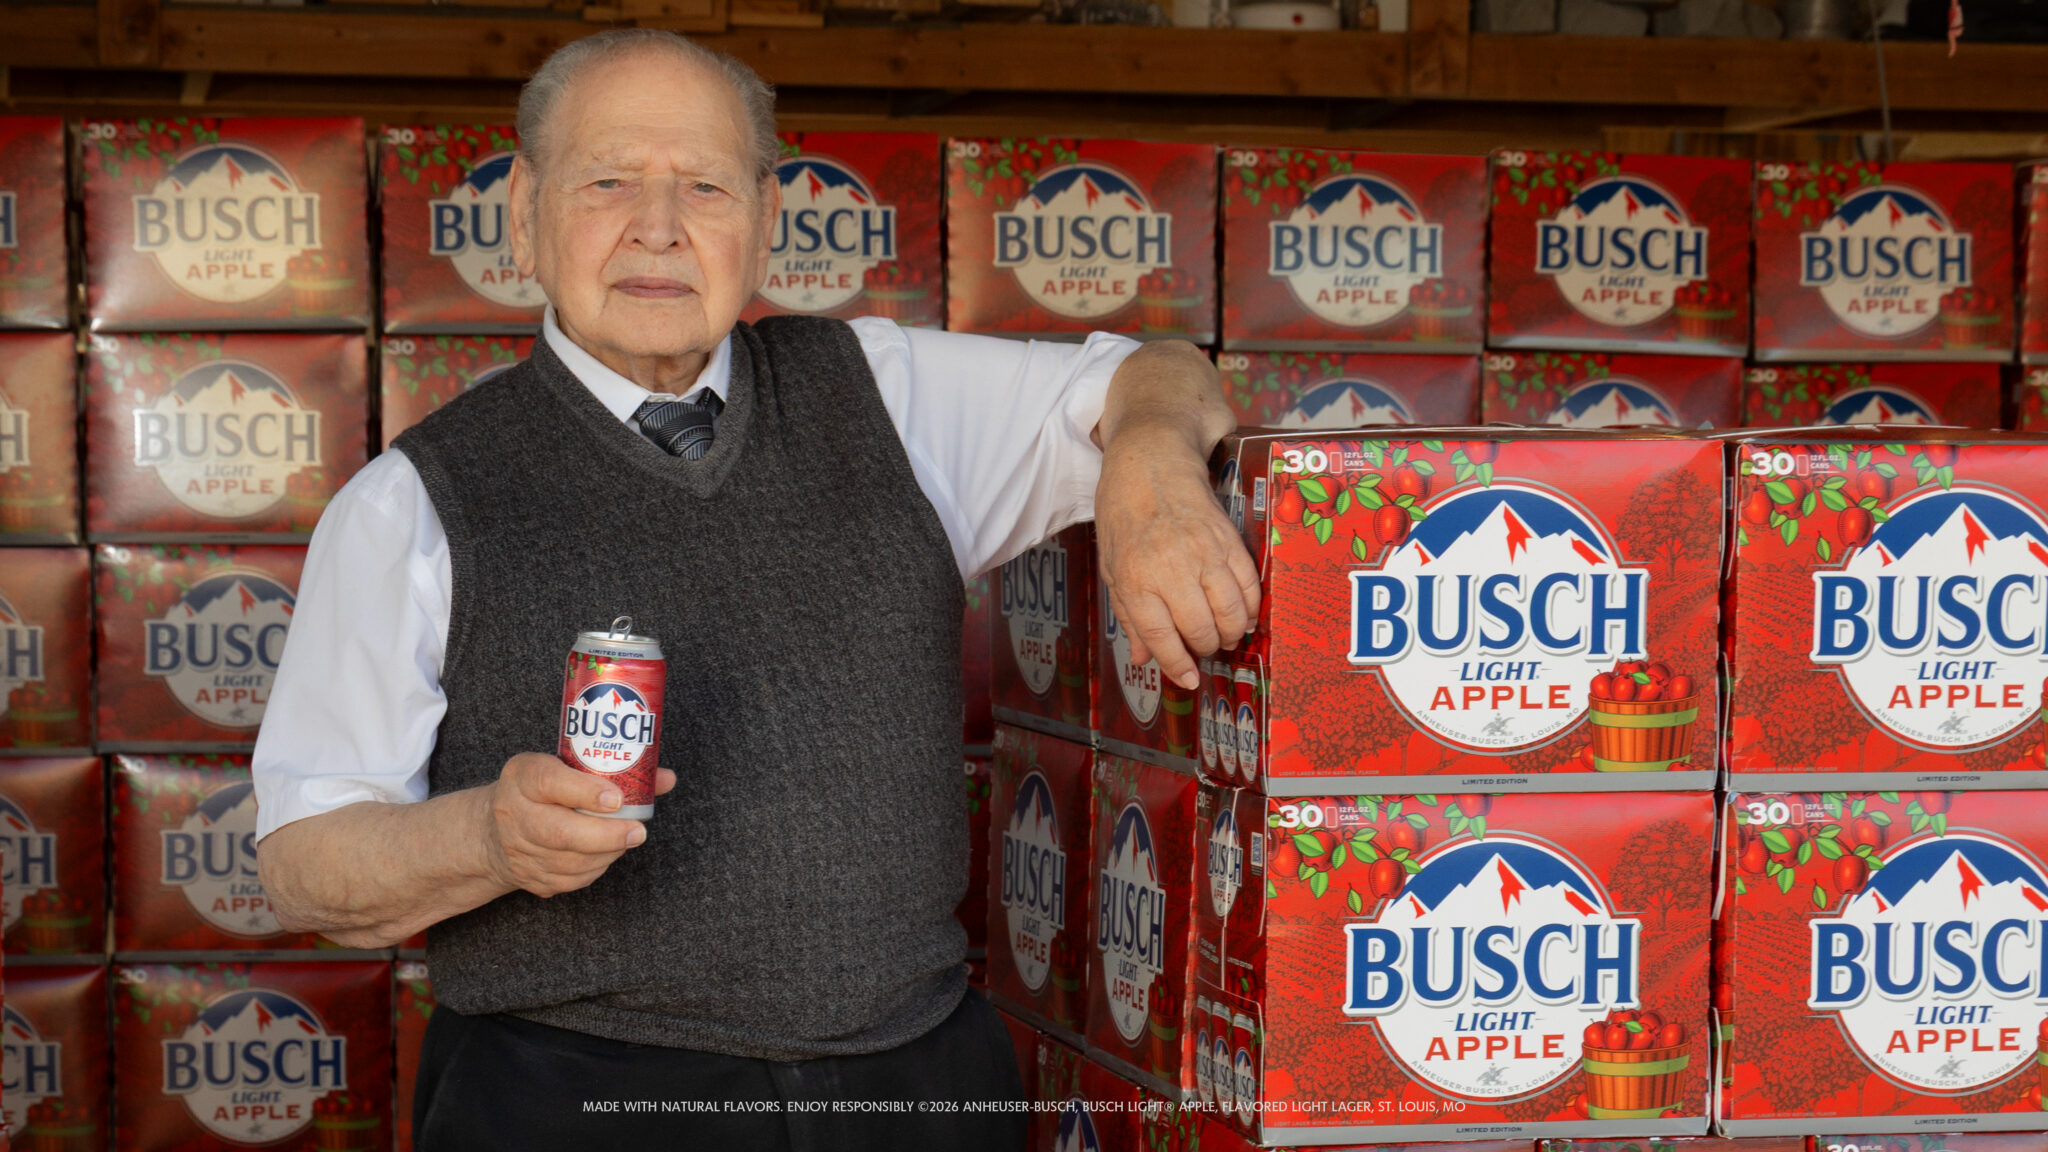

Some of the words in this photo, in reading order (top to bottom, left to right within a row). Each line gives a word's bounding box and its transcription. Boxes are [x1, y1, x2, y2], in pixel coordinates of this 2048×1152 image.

[88, 123, 117, 140] 30
[387, 129, 416, 145] 30
[953, 142, 981, 158] 30
[1231, 151, 1258, 166] 30
[1500, 151, 1527, 167] 30
[1762, 164, 1790, 180] 30
[136, 196, 316, 247] BUSCH
[771, 209, 892, 257] USCH
[997, 215, 1167, 264] BUSCH
[204, 250, 255, 262] LIGHT
[1273, 224, 1438, 273] BUSCH
[1540, 224, 1703, 276] BUSCH
[784, 259, 833, 272] LIGHT
[1805, 237, 1966, 283] BUSCH
[186, 263, 275, 280] APPLE
[481, 268, 541, 284] APP
[1060, 266, 1108, 278] LIGHT
[768, 274, 852, 288] APPLE
[1043, 280, 1126, 295] APPLE
[1333, 275, 1381, 288] LIGHT
[1599, 275, 1646, 288] LIGHT
[1316, 289, 1398, 304] APPLE
[1581, 288, 1663, 305] APPLE
[1864, 285, 1911, 297] LIGHT
[1848, 299, 1929, 314] APPLE
[387, 340, 416, 355] 30
[1221, 355, 1250, 371] 30
[1488, 355, 1516, 371] 30
[1751, 369, 1778, 382] 30
[138, 412, 316, 462] BUSCH
[1282, 450, 1328, 473] 30
[1751, 452, 1795, 476] 30
[204, 465, 255, 477] LIGHT
[186, 479, 275, 494] APPLE
[1002, 548, 1067, 622] BUSCH
[1354, 573, 1645, 657] BUSCH
[1819, 574, 2048, 657] BUSC
[149, 623, 289, 671] BUSC
[588, 649, 616, 657] LIMITED
[1020, 639, 1052, 665] APPLE
[1125, 663, 1157, 690] APPLE
[1460, 661, 1542, 681] LIGHT
[1918, 661, 1997, 680] LIGHT
[213, 675, 263, 687] LIGHT
[196, 689, 271, 704] APPL
[1430, 685, 1571, 710] APPLE
[1888, 684, 2024, 709] APPLE
[1566, 707, 1579, 718] MO
[2019, 707, 2032, 718] MO
[566, 707, 655, 743] BUSCH
[582, 748, 632, 761] APPLE
[593, 741, 624, 751] LIGHT
[1278, 804, 1323, 828] 30
[1746, 802, 1790, 825] 30
[165, 832, 258, 881] BUS
[1003, 836, 1066, 926] BUSCH
[212, 898, 273, 912] APP
[1022, 915, 1041, 937] LIGHT
[1100, 873, 1165, 970] BUSCH
[1016, 932, 1046, 963] APPLE
[1350, 924, 1637, 1009] BUSCH
[1815, 919, 2048, 1002] BUSC
[1119, 959, 1138, 982] LIGHT
[1113, 977, 1144, 1011] APPLE
[1454, 1011, 1536, 1032] LIGHT
[1915, 1005, 1993, 1025] LIGHT
[1424, 1034, 1565, 1061] APPLE
[1886, 1027, 2020, 1054] APPLE
[1560, 1056, 1573, 1067] MO
[2016, 1050, 2028, 1060] MO
[166, 1040, 342, 1091] BUSCH
[232, 1091, 282, 1104] LIGHT
[213, 1105, 300, 1121] APPLE
